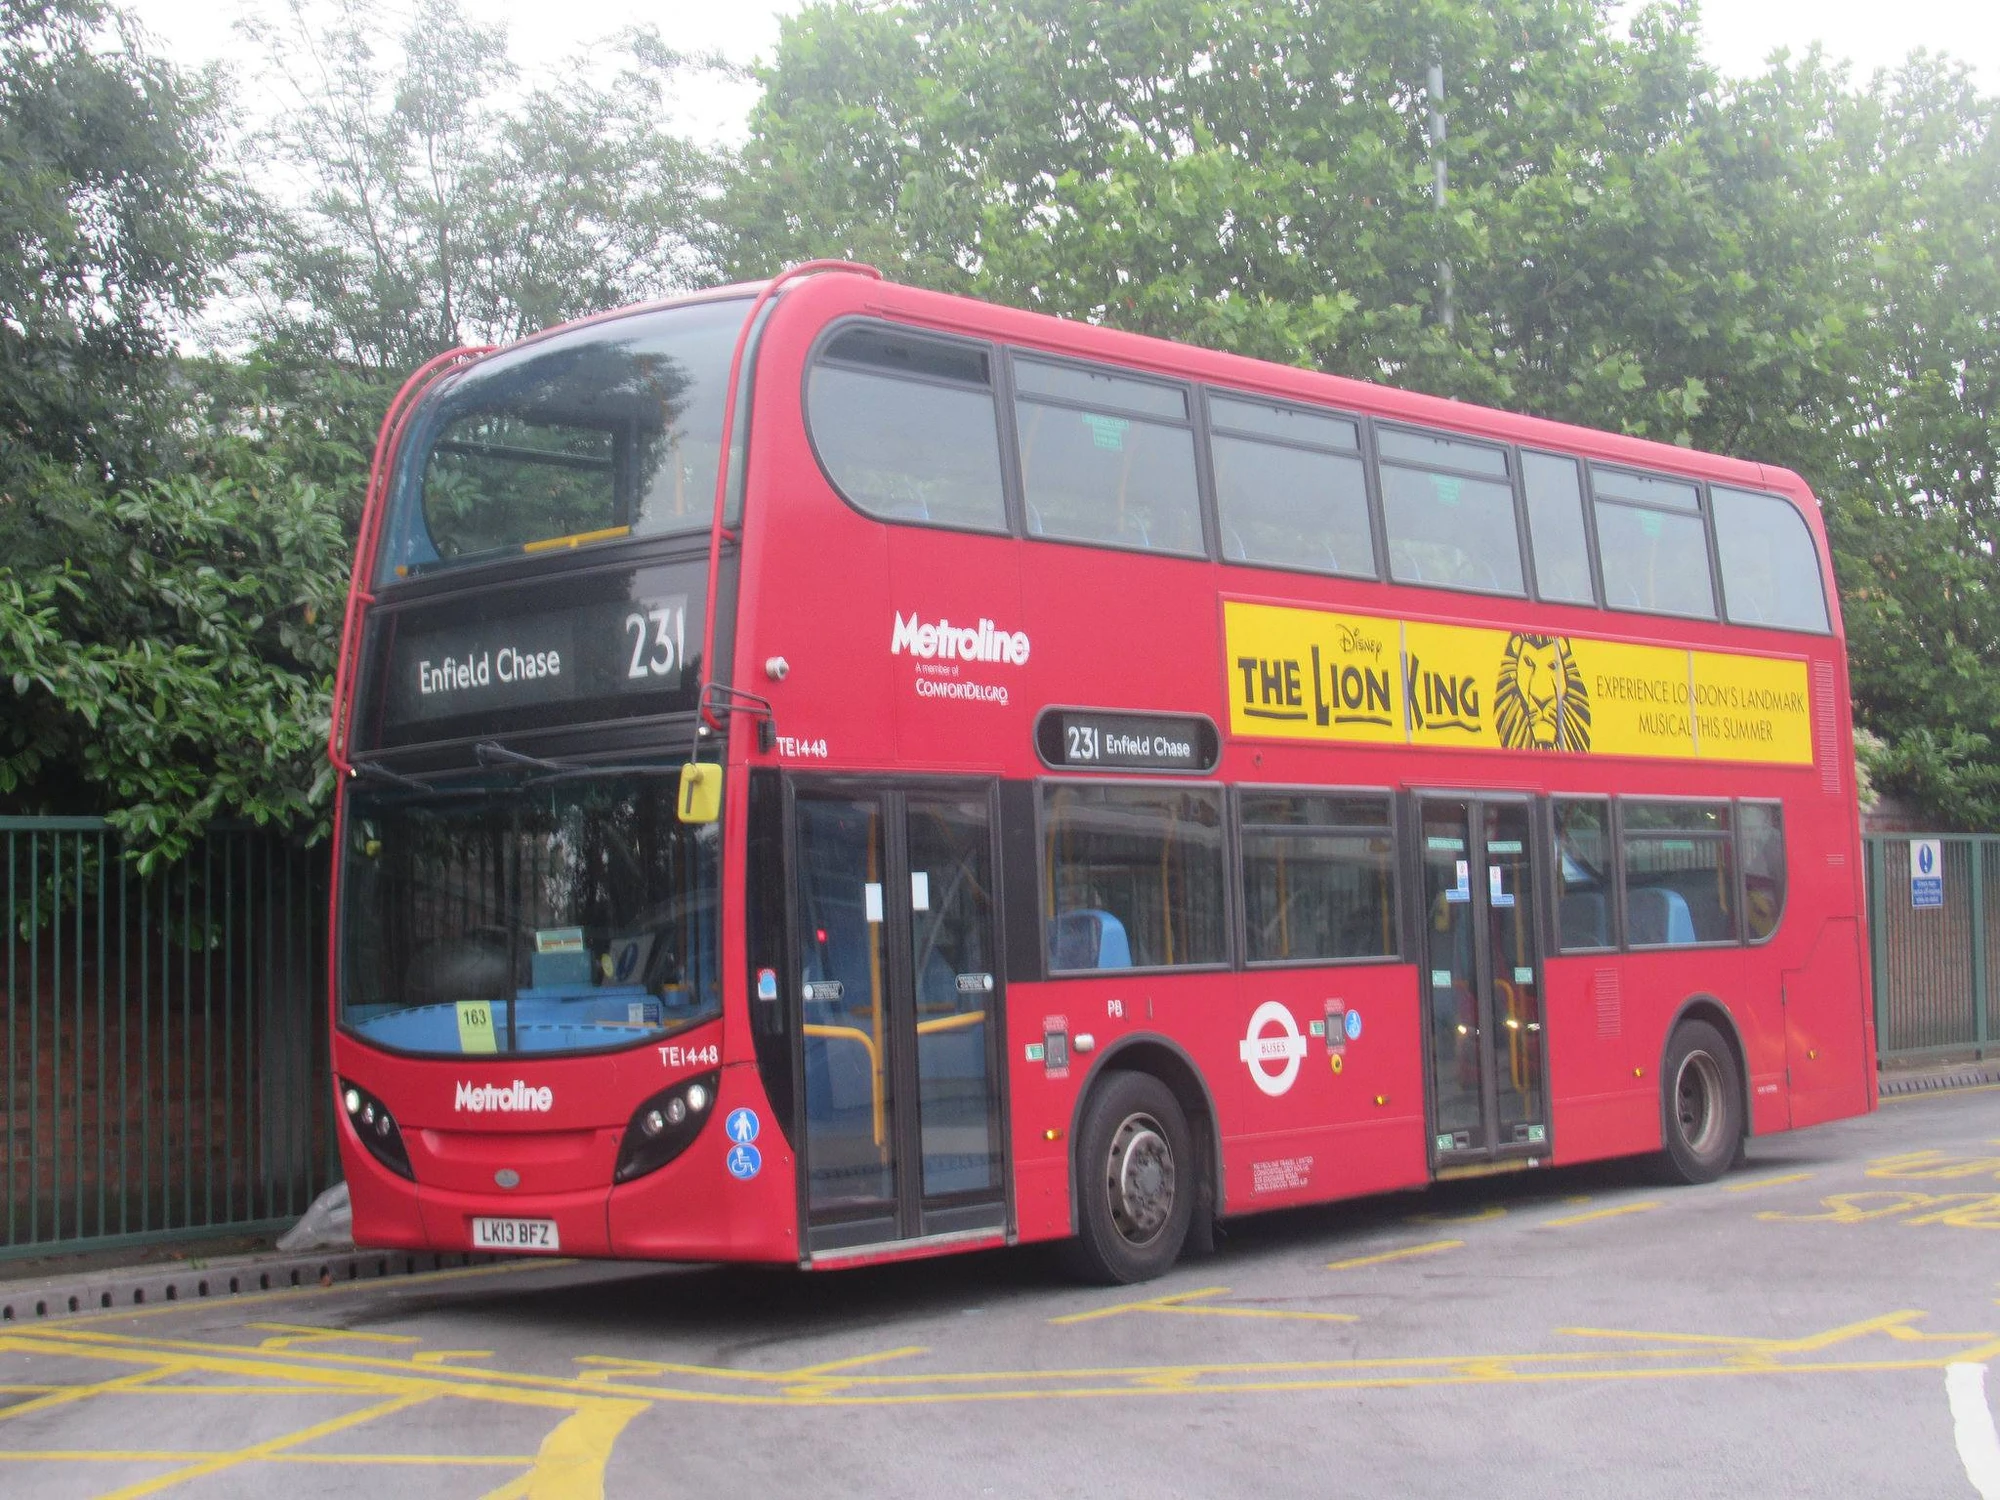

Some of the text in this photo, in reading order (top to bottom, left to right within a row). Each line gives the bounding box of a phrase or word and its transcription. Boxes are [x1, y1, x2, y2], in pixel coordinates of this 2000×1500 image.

[625, 607, 685, 679] 231
[890, 610, 1030, 666] Metroline
[1335, 623, 1383, 663] Disney
[419, 647, 560, 694] Enfield Chase
[915, 662, 921, 673] A
[922, 663, 950, 677] member
[1237, 645, 1480, 731] THE LION KING
[1596, 675, 1805, 714] EXPERIENCE LONDON'S LANDMARK
[1067, 726, 1191, 760] 231 Enfield Chase
[1639, 712, 1774, 742] MUSICAL THIS SUMMER
[775, 736, 828, 758] TE1448
[463, 1008, 487, 1026] 163
[657, 1044, 719, 1068] TE1448
[1260, 1041, 1287, 1055] BUSES
[454, 1079, 553, 1113] Metroline
[481, 1219, 550, 1246] LK13 BFZ
